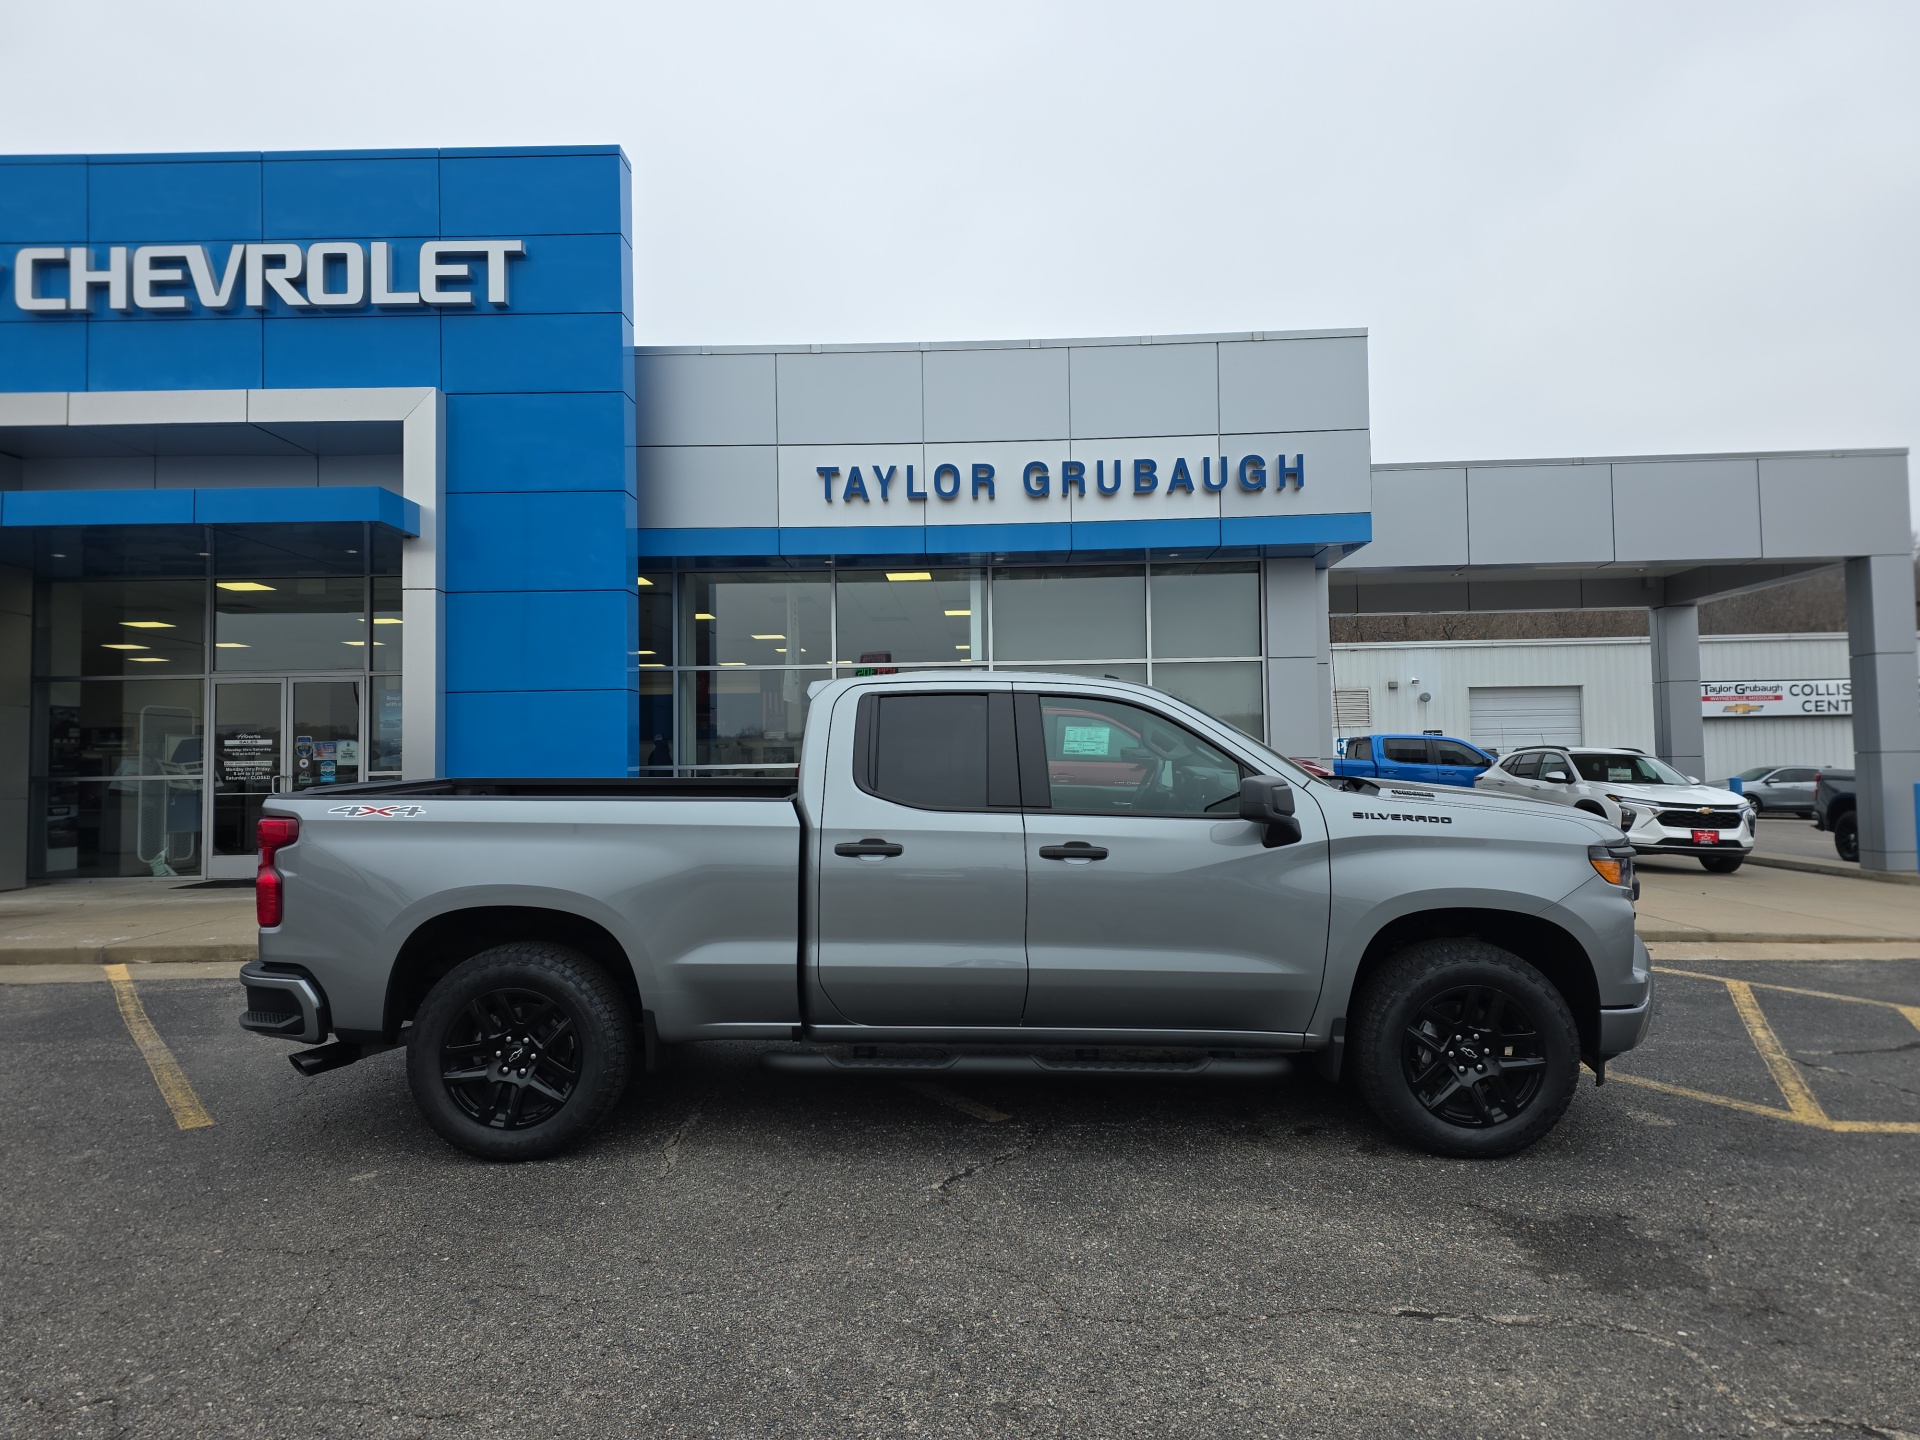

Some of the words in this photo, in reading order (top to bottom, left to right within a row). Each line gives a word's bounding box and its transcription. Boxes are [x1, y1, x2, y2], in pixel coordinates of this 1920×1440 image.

[15, 240, 525, 312] CHEVROLET
[816, 463, 996, 502] TAYLOR
[1022, 454, 1304, 498] GRUBAUGH
[1701, 684, 1733, 695] Taylor
[1734, 683, 1783, 694] Grubaugh
[1352, 812, 1452, 824] SILVERADO
